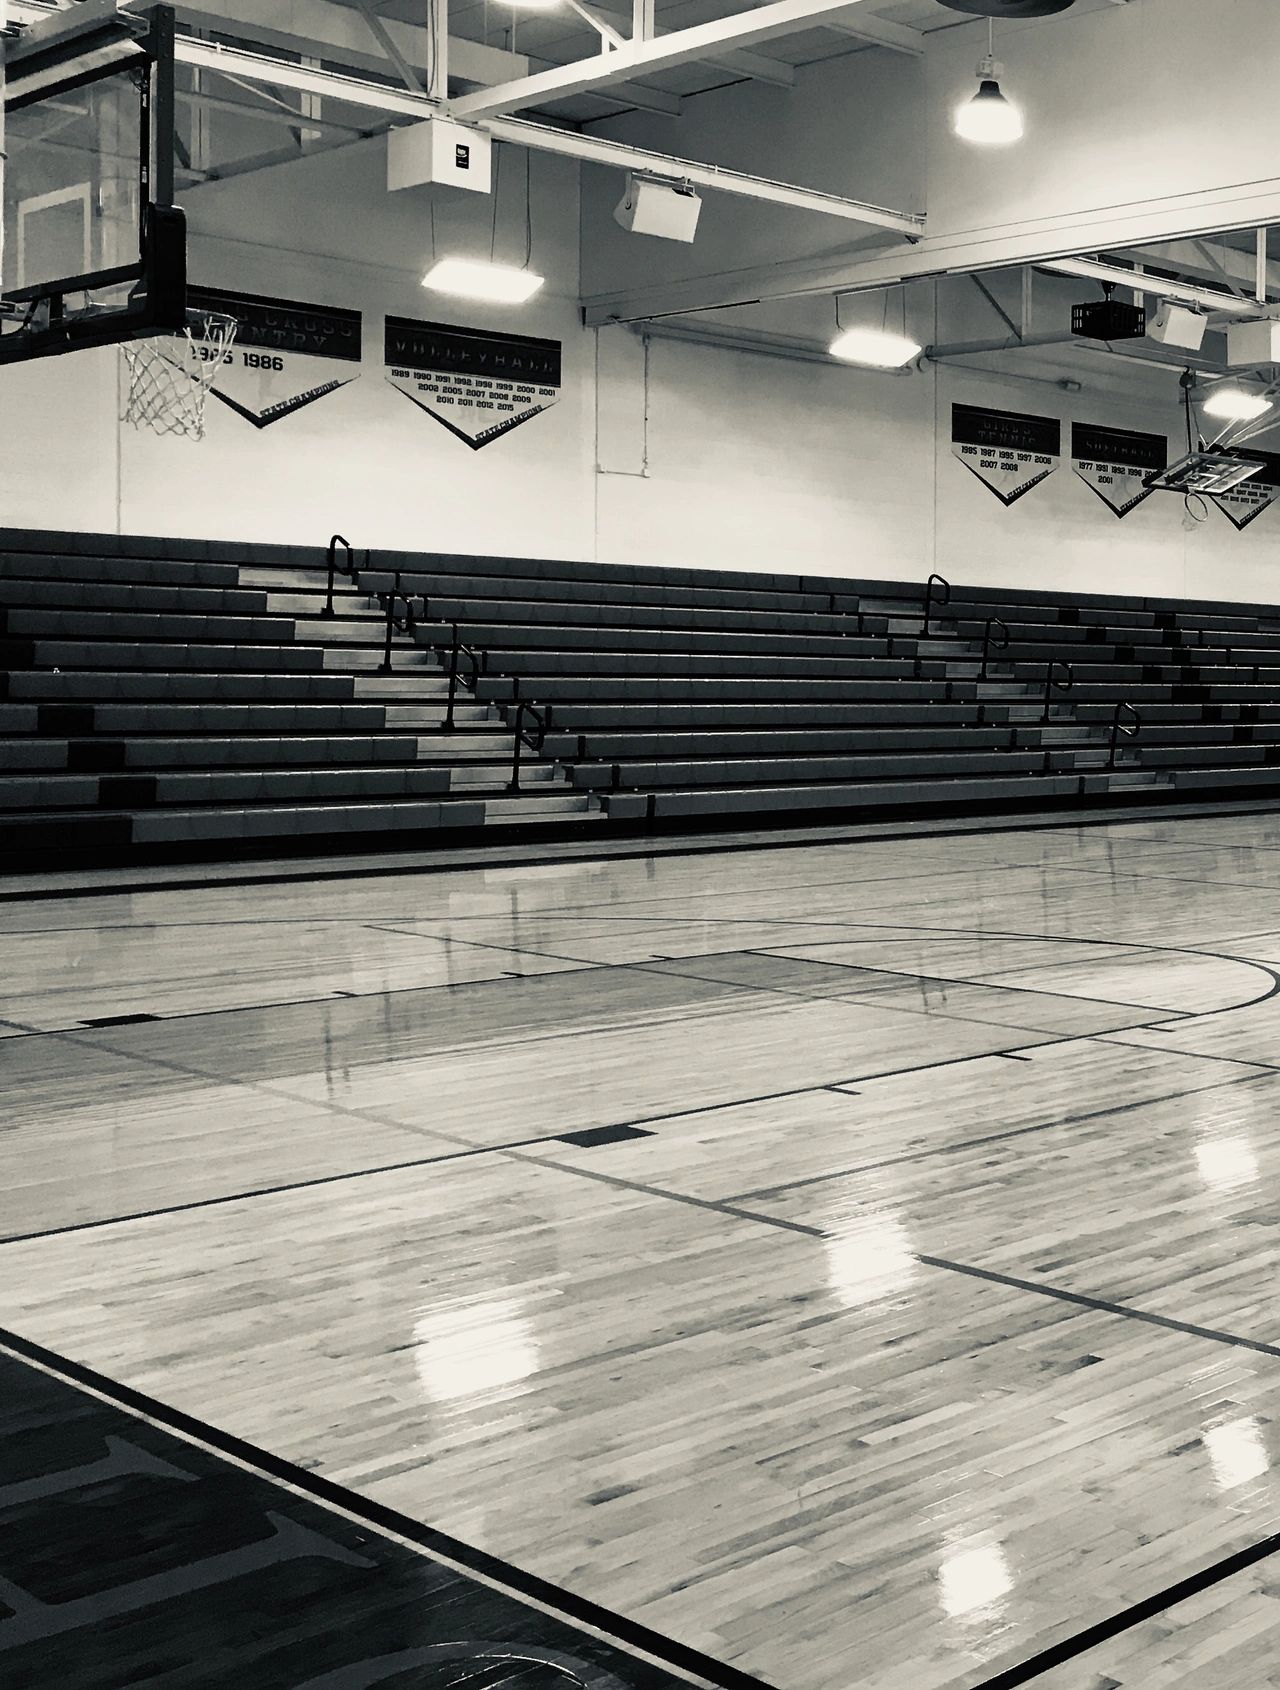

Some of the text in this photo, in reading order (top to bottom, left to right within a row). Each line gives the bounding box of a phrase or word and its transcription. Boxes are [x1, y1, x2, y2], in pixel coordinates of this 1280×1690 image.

[242, 352, 284, 371] 1986
[418, 383, 439, 392] 2002
[442, 386, 463, 396] 2005
[466, 389, 486, 398] 2007
[516, 385, 536, 394] 2000
[538, 388, 556, 397] 2001
[260, 379, 340, 417] STATE CHAMPIONS
[436, 396, 454, 405] 2010
[458, 398, 473, 407] 2011
[476, 400, 494, 409] 2012
[475, 404, 544, 441] STATE CHAMPIONS
[980, 460, 998, 469] 2007
[1098, 476, 1113, 484] 2001
